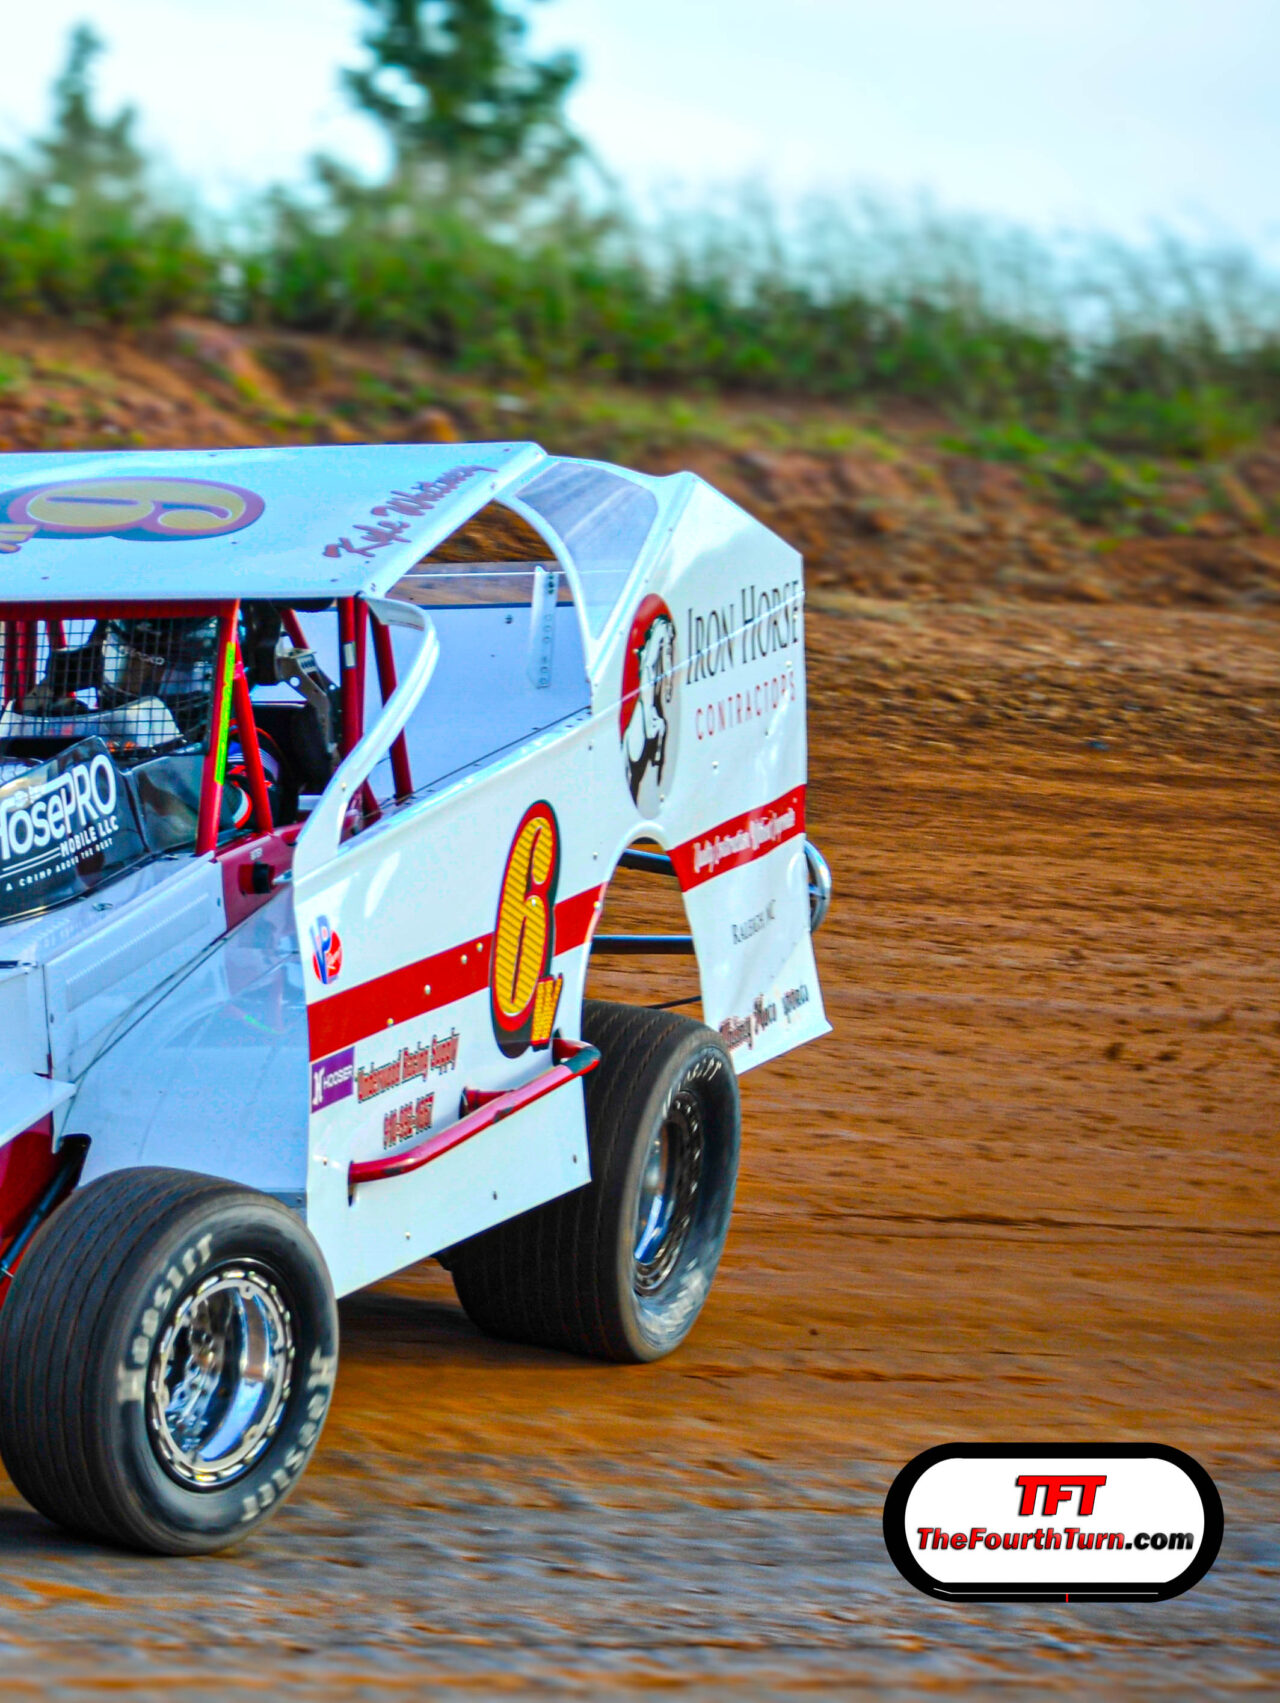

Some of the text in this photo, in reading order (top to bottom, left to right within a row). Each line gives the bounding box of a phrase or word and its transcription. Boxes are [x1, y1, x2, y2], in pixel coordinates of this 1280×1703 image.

[686, 580, 800, 685] IRON HORSE
[696, 670, 796, 741] CONTRACTORS
[60, 815, 119, 857] MOBILE LLC
[5, 882, 14, 892] A
[19, 868, 53, 887] CRIMP
